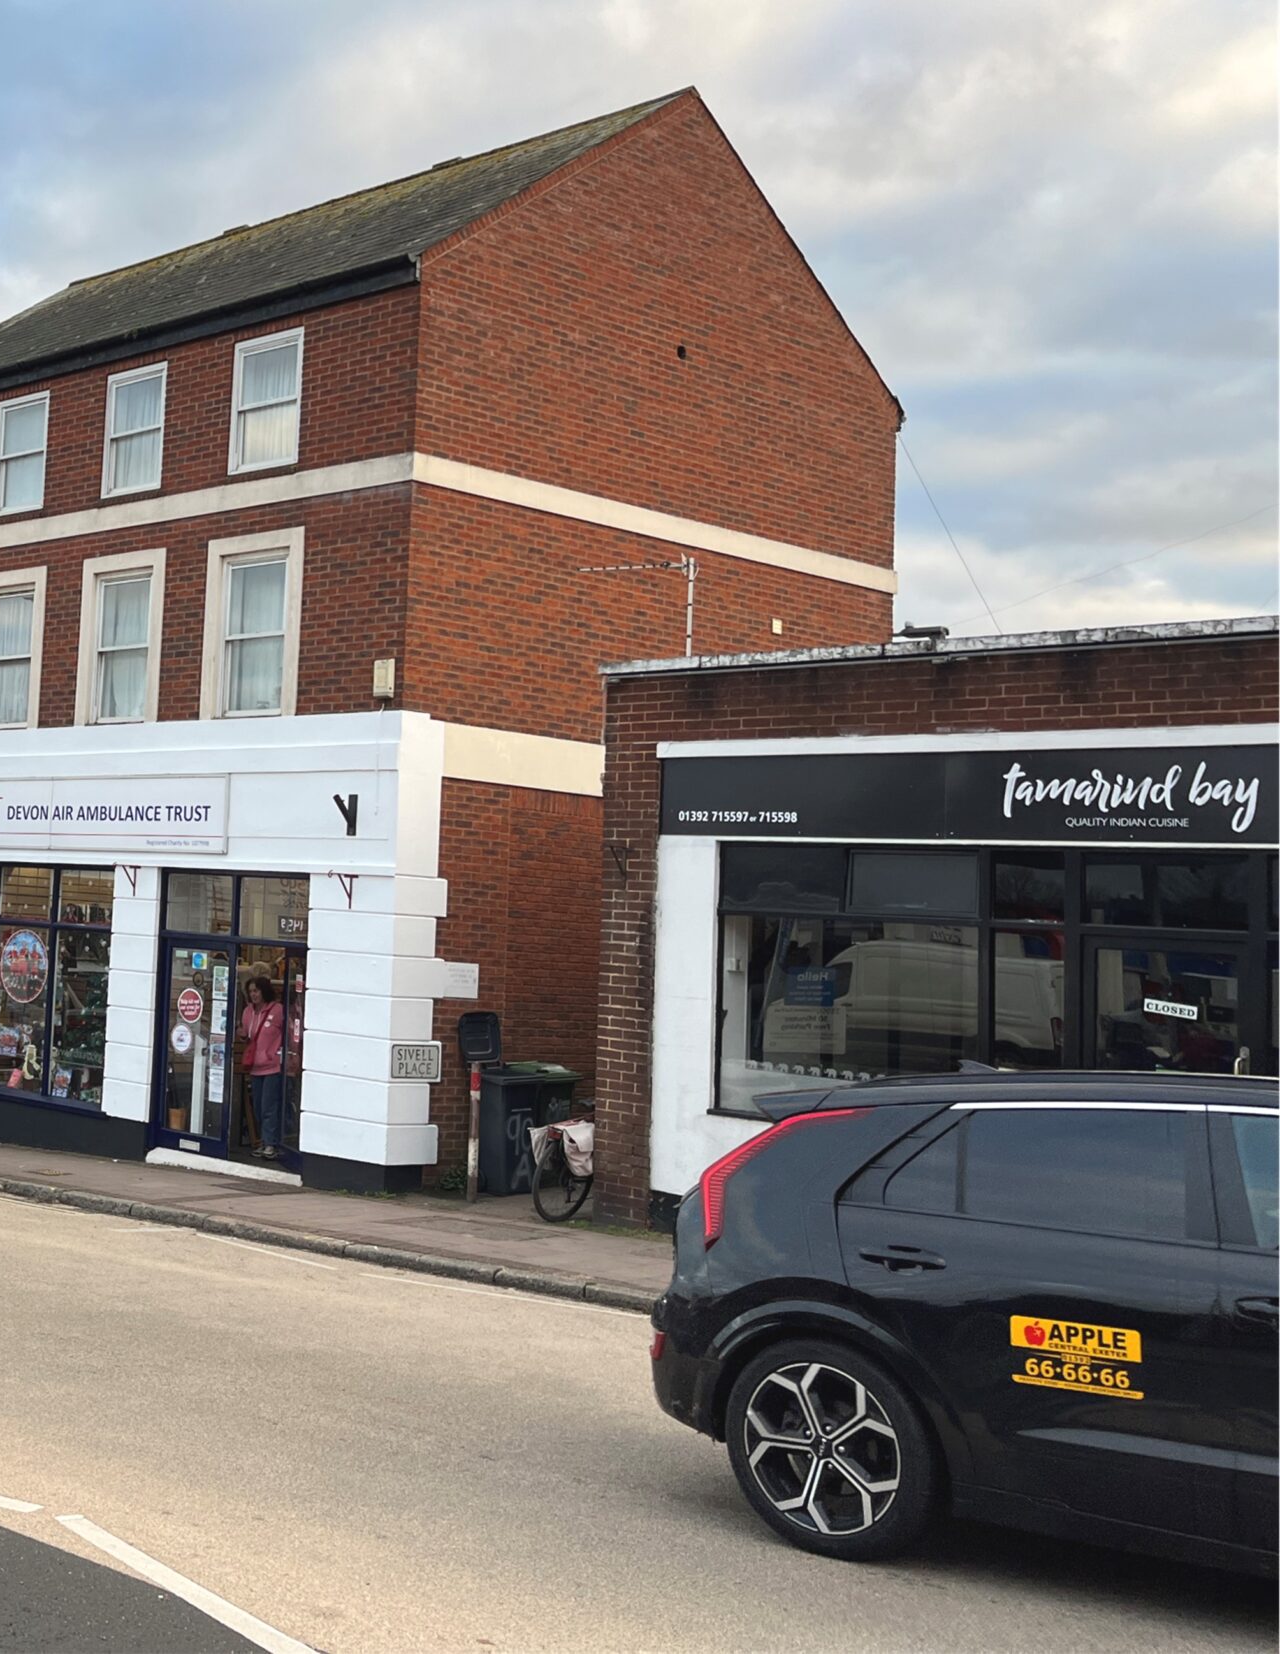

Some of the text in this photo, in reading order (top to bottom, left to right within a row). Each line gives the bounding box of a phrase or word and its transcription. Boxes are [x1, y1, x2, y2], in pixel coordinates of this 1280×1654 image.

[1003, 761, 1260, 833] tamarind bay
[7, 804, 211, 822] DEVON AIR AMBULANCE TRUST
[678, 810, 709, 822] 01392
[711, 811, 749, 823] 715597
[758, 811, 798, 823] 715598
[1065, 817, 1190, 828] QUALITY INDIAN CUISINE
[1146, 1001, 1196, 1018] CLOSED
[397, 1048, 434, 1062] SIVELL
[398, 1061, 432, 1076] PLACE
[1048, 1323, 1127, 1351] APPLE
[1048, 1342, 1128, 1359] CENTRAL EXETER
